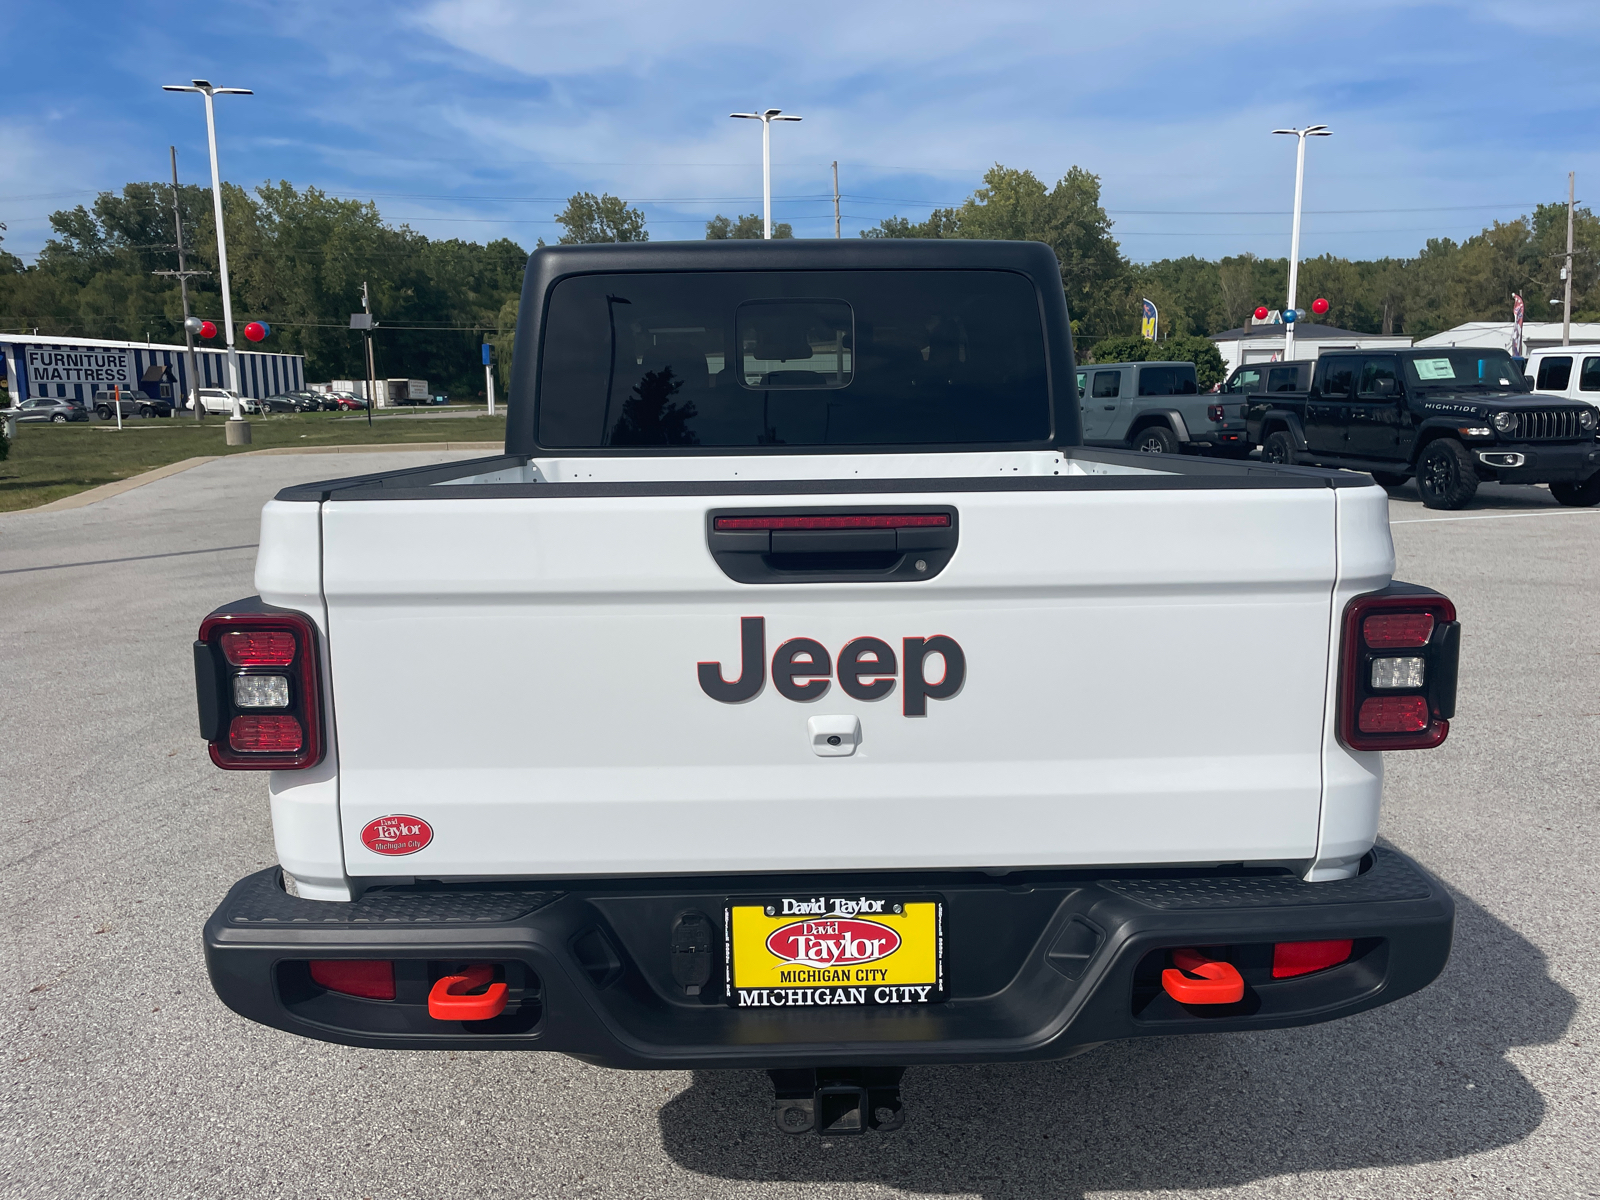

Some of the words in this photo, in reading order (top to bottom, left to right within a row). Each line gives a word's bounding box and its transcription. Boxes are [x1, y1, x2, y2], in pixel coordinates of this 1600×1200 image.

[29, 352, 127, 368] FURNITURE
[34, 367, 127, 381] MATTRESS
[697, 616, 966, 717] Jeep
[380, 818, 398, 826] David
[372, 822, 421, 842] Taylor
[375, 842, 406, 850] Michigan
[407, 840, 421, 848] City
[781, 897, 827, 914] David
[821, 897, 886, 918] Taylor
[802, 922, 839, 935] David
[776, 931, 886, 969] Taylor
[780, 970, 851, 983] MICHIGAN
[855, 969, 888, 981] CITY
[738, 988, 867, 1006] MICHIGAN
[874, 986, 932, 1003] CITY
